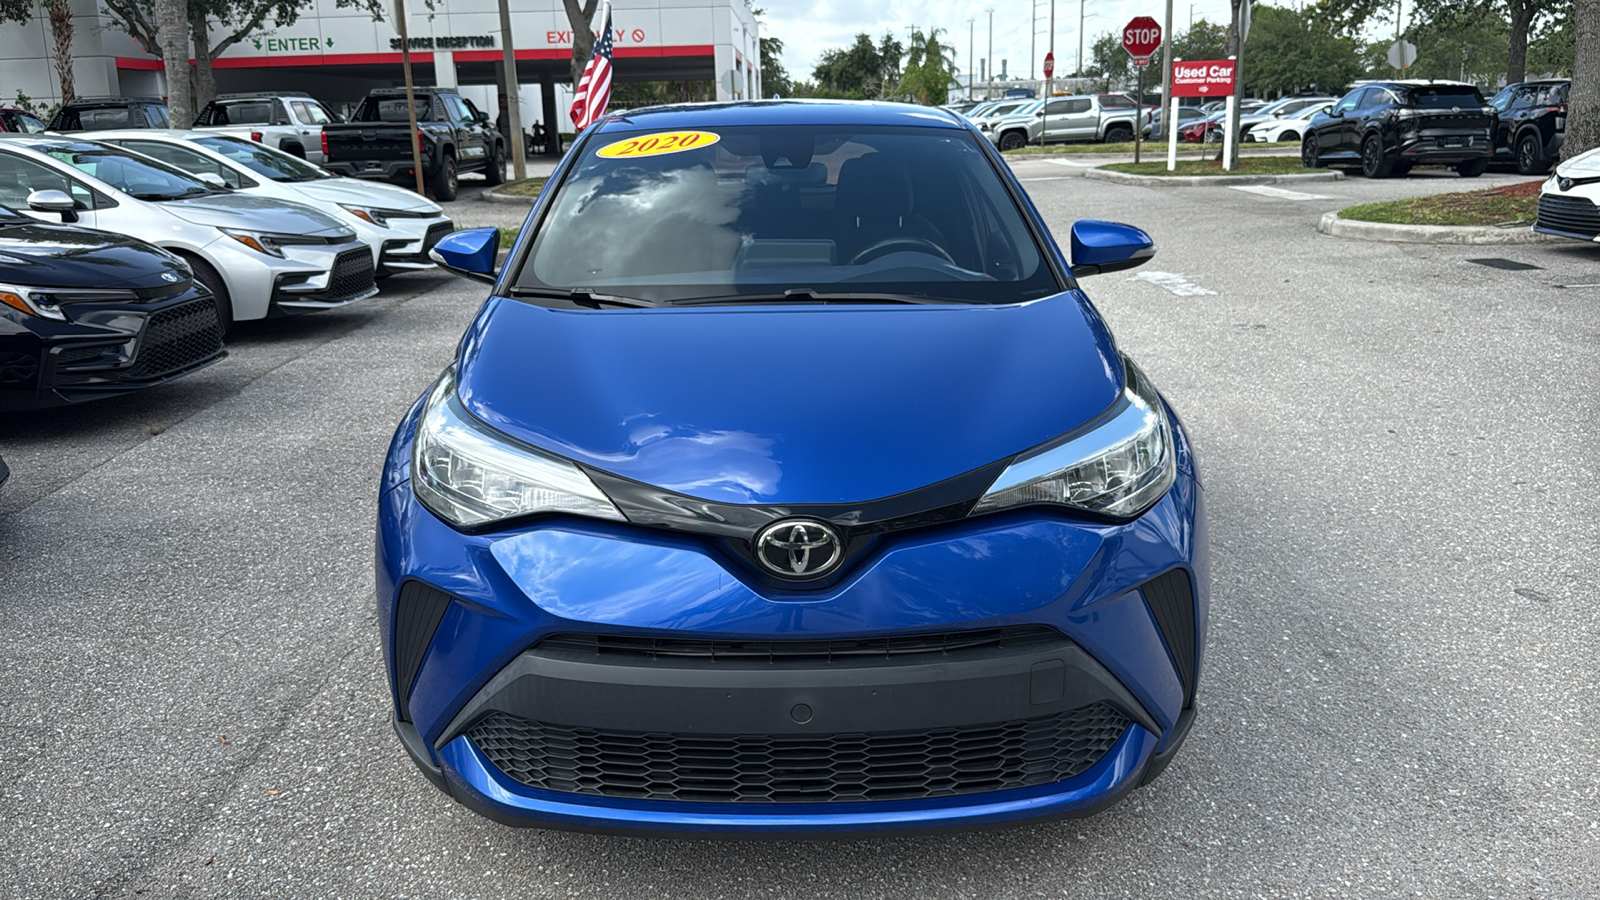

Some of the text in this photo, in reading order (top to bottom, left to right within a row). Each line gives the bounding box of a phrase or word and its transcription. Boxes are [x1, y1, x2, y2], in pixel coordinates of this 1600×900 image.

[435, 35, 495, 49] RECEPTION
[1125, 28, 1159, 45] STOP
[267, 37, 320, 51] ENTER
[1174, 65, 1233, 78] Used Car
[615, 133, 700, 156] 2020
